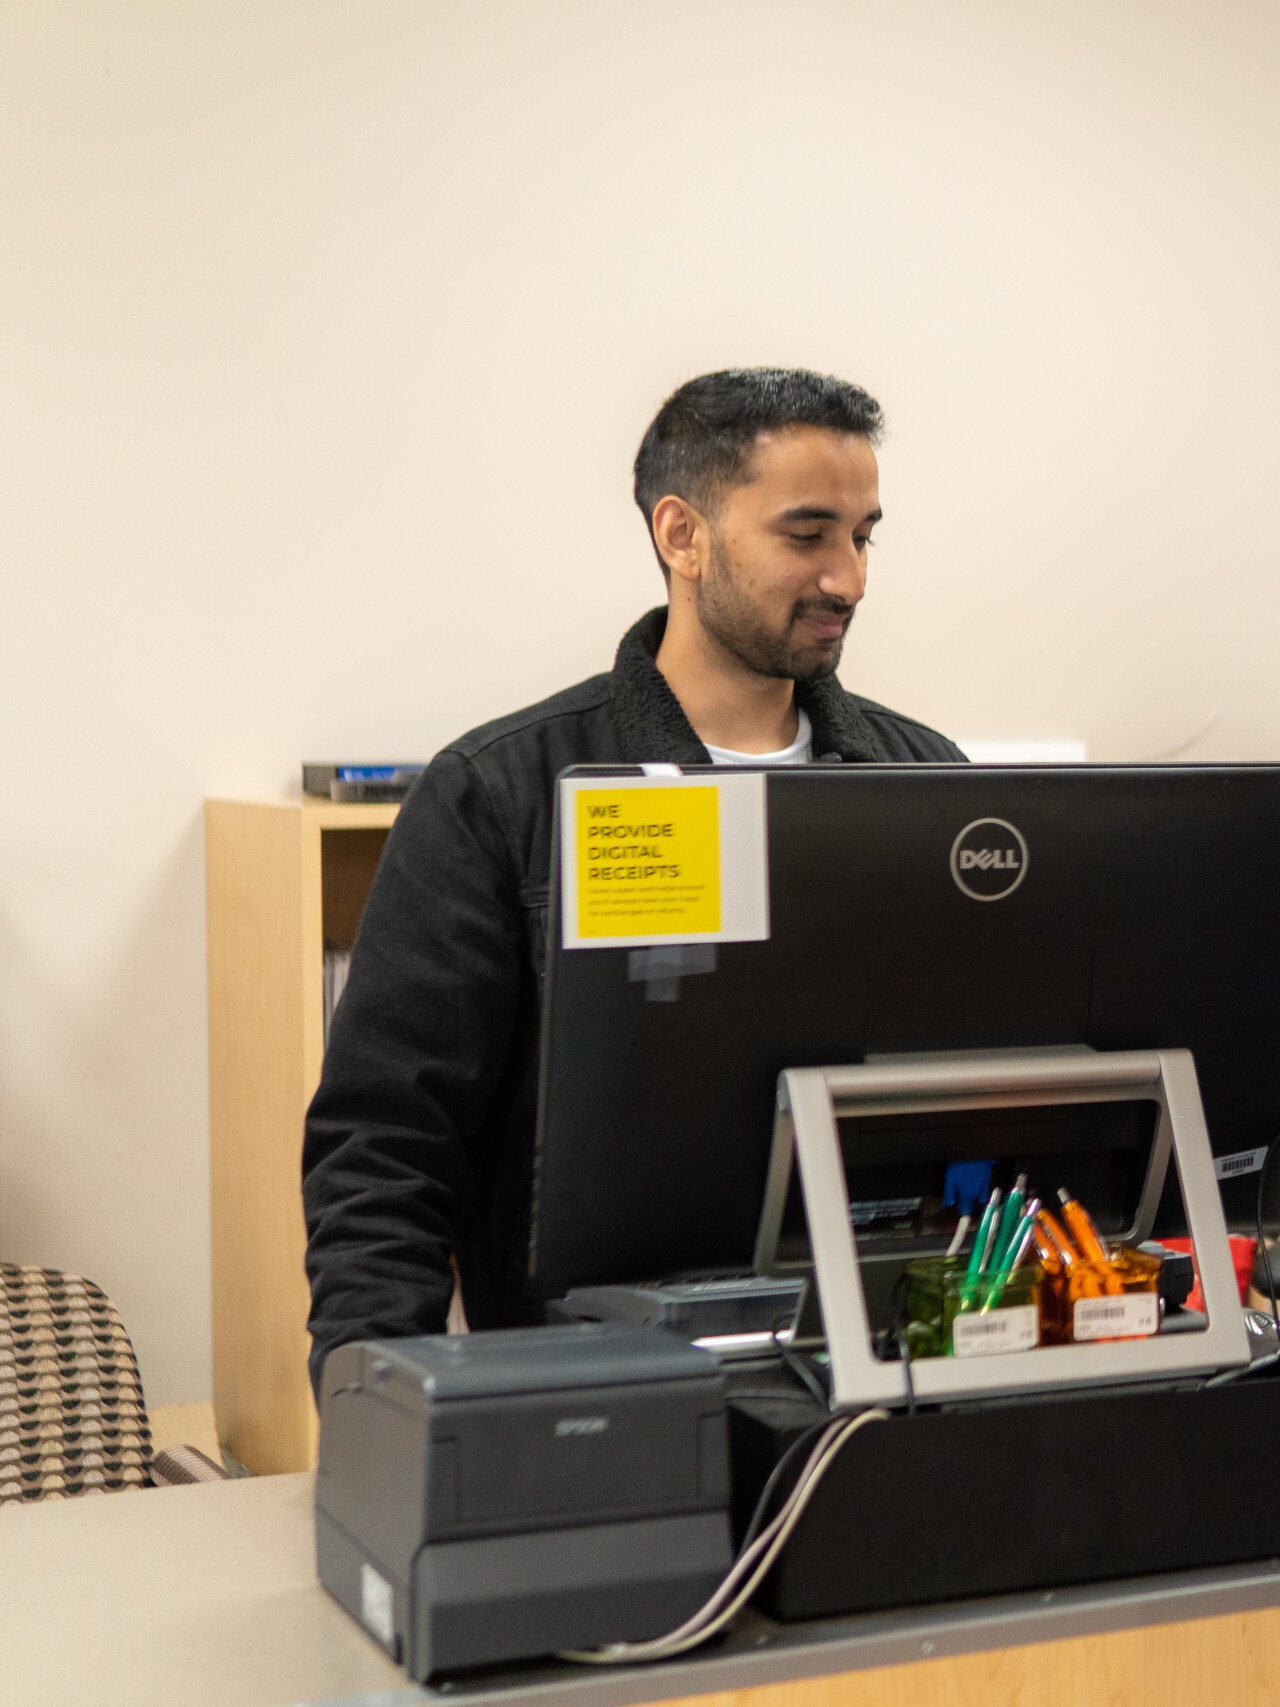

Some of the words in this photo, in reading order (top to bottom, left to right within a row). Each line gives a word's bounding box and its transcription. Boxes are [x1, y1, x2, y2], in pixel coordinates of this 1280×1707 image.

[587, 804, 620, 819] WE
[588, 823, 675, 839] PROVIDE
[588, 845, 664, 860] DIGITAL
[959, 848, 1020, 871] DELL
[588, 864, 681, 880] RECEIPTS
